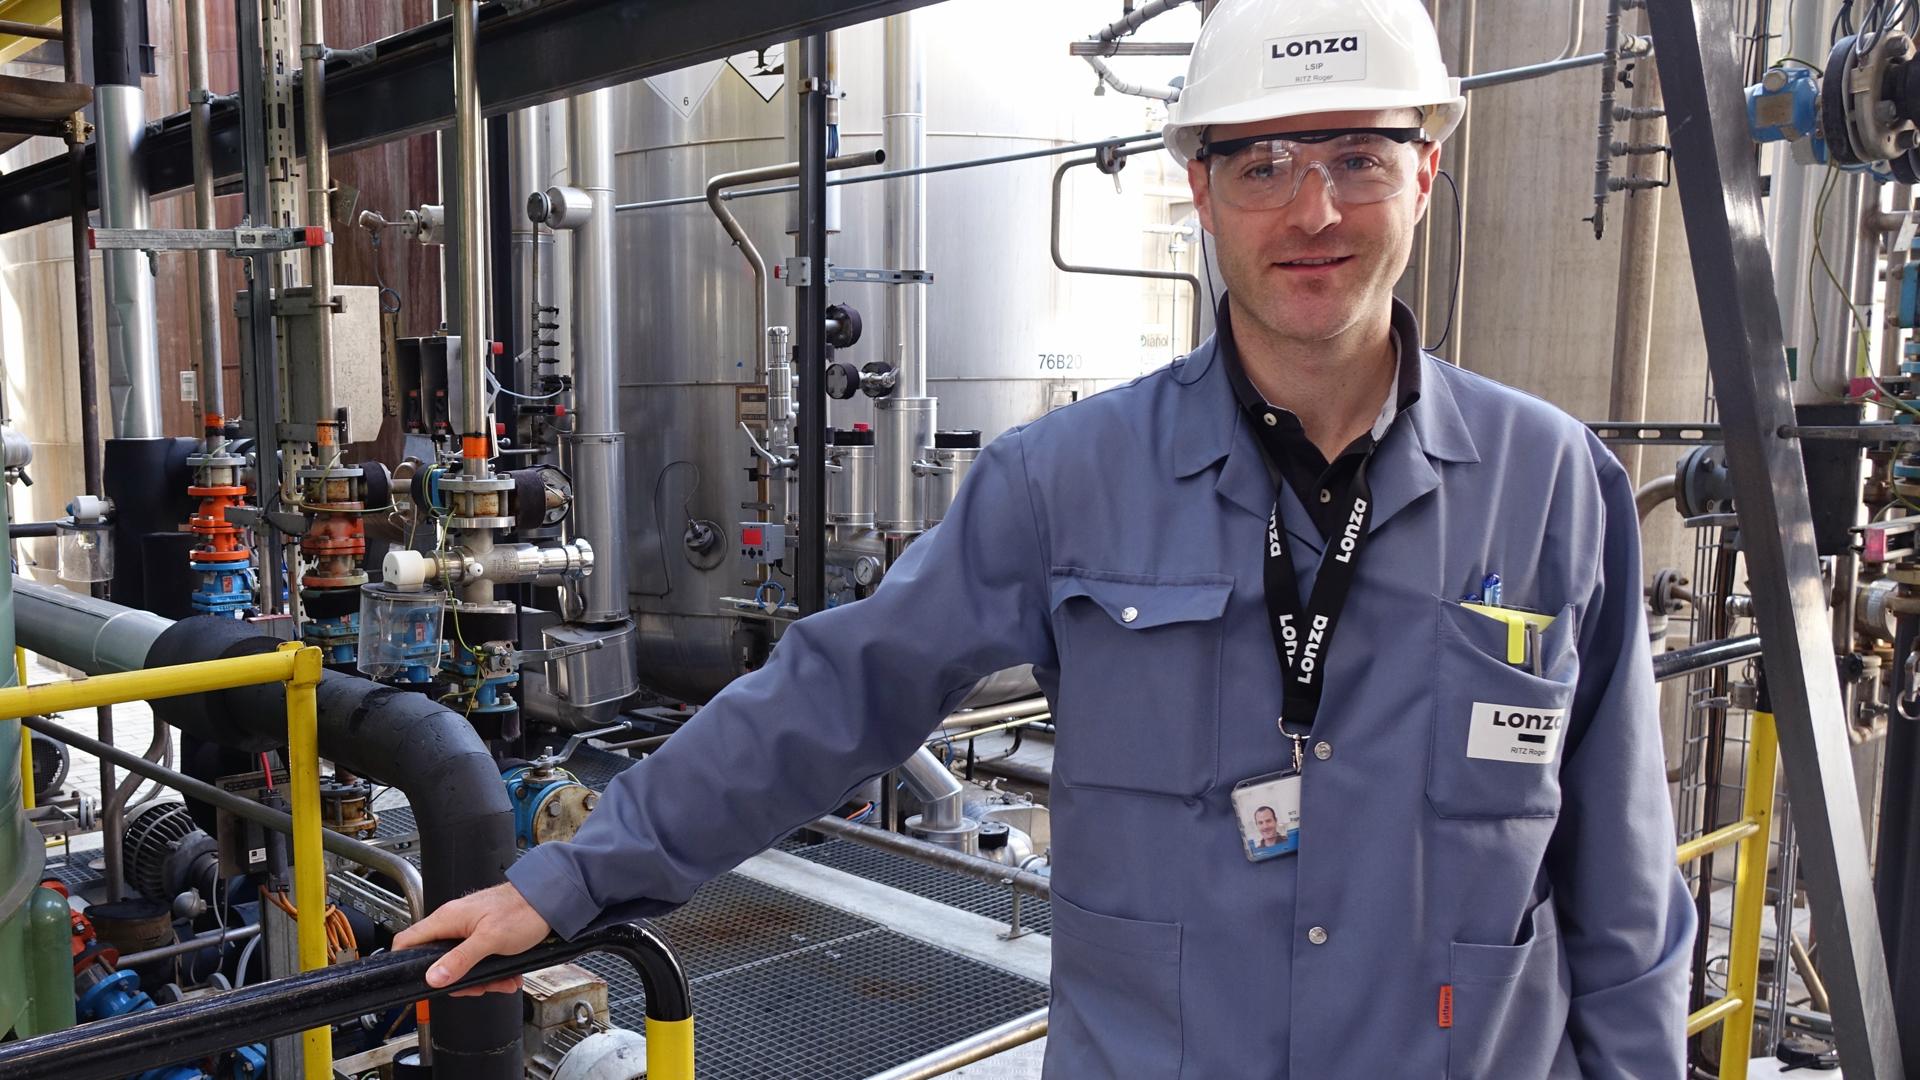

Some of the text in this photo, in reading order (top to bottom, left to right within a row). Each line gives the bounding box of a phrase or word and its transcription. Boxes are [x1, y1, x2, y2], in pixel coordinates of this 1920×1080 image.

[1271, 36, 1358, 59] Lonza
[1304, 62, 1324, 71] LSIP
[1313, 74, 1334, 83] Roger
[683, 96, 689, 106] 6
[1038, 353, 1083, 370] 76B20
[1335, 497, 1368, 564] Lonza
[1297, 614, 1329, 684] Lonza
[1510, 746, 1528, 755] RITZ
